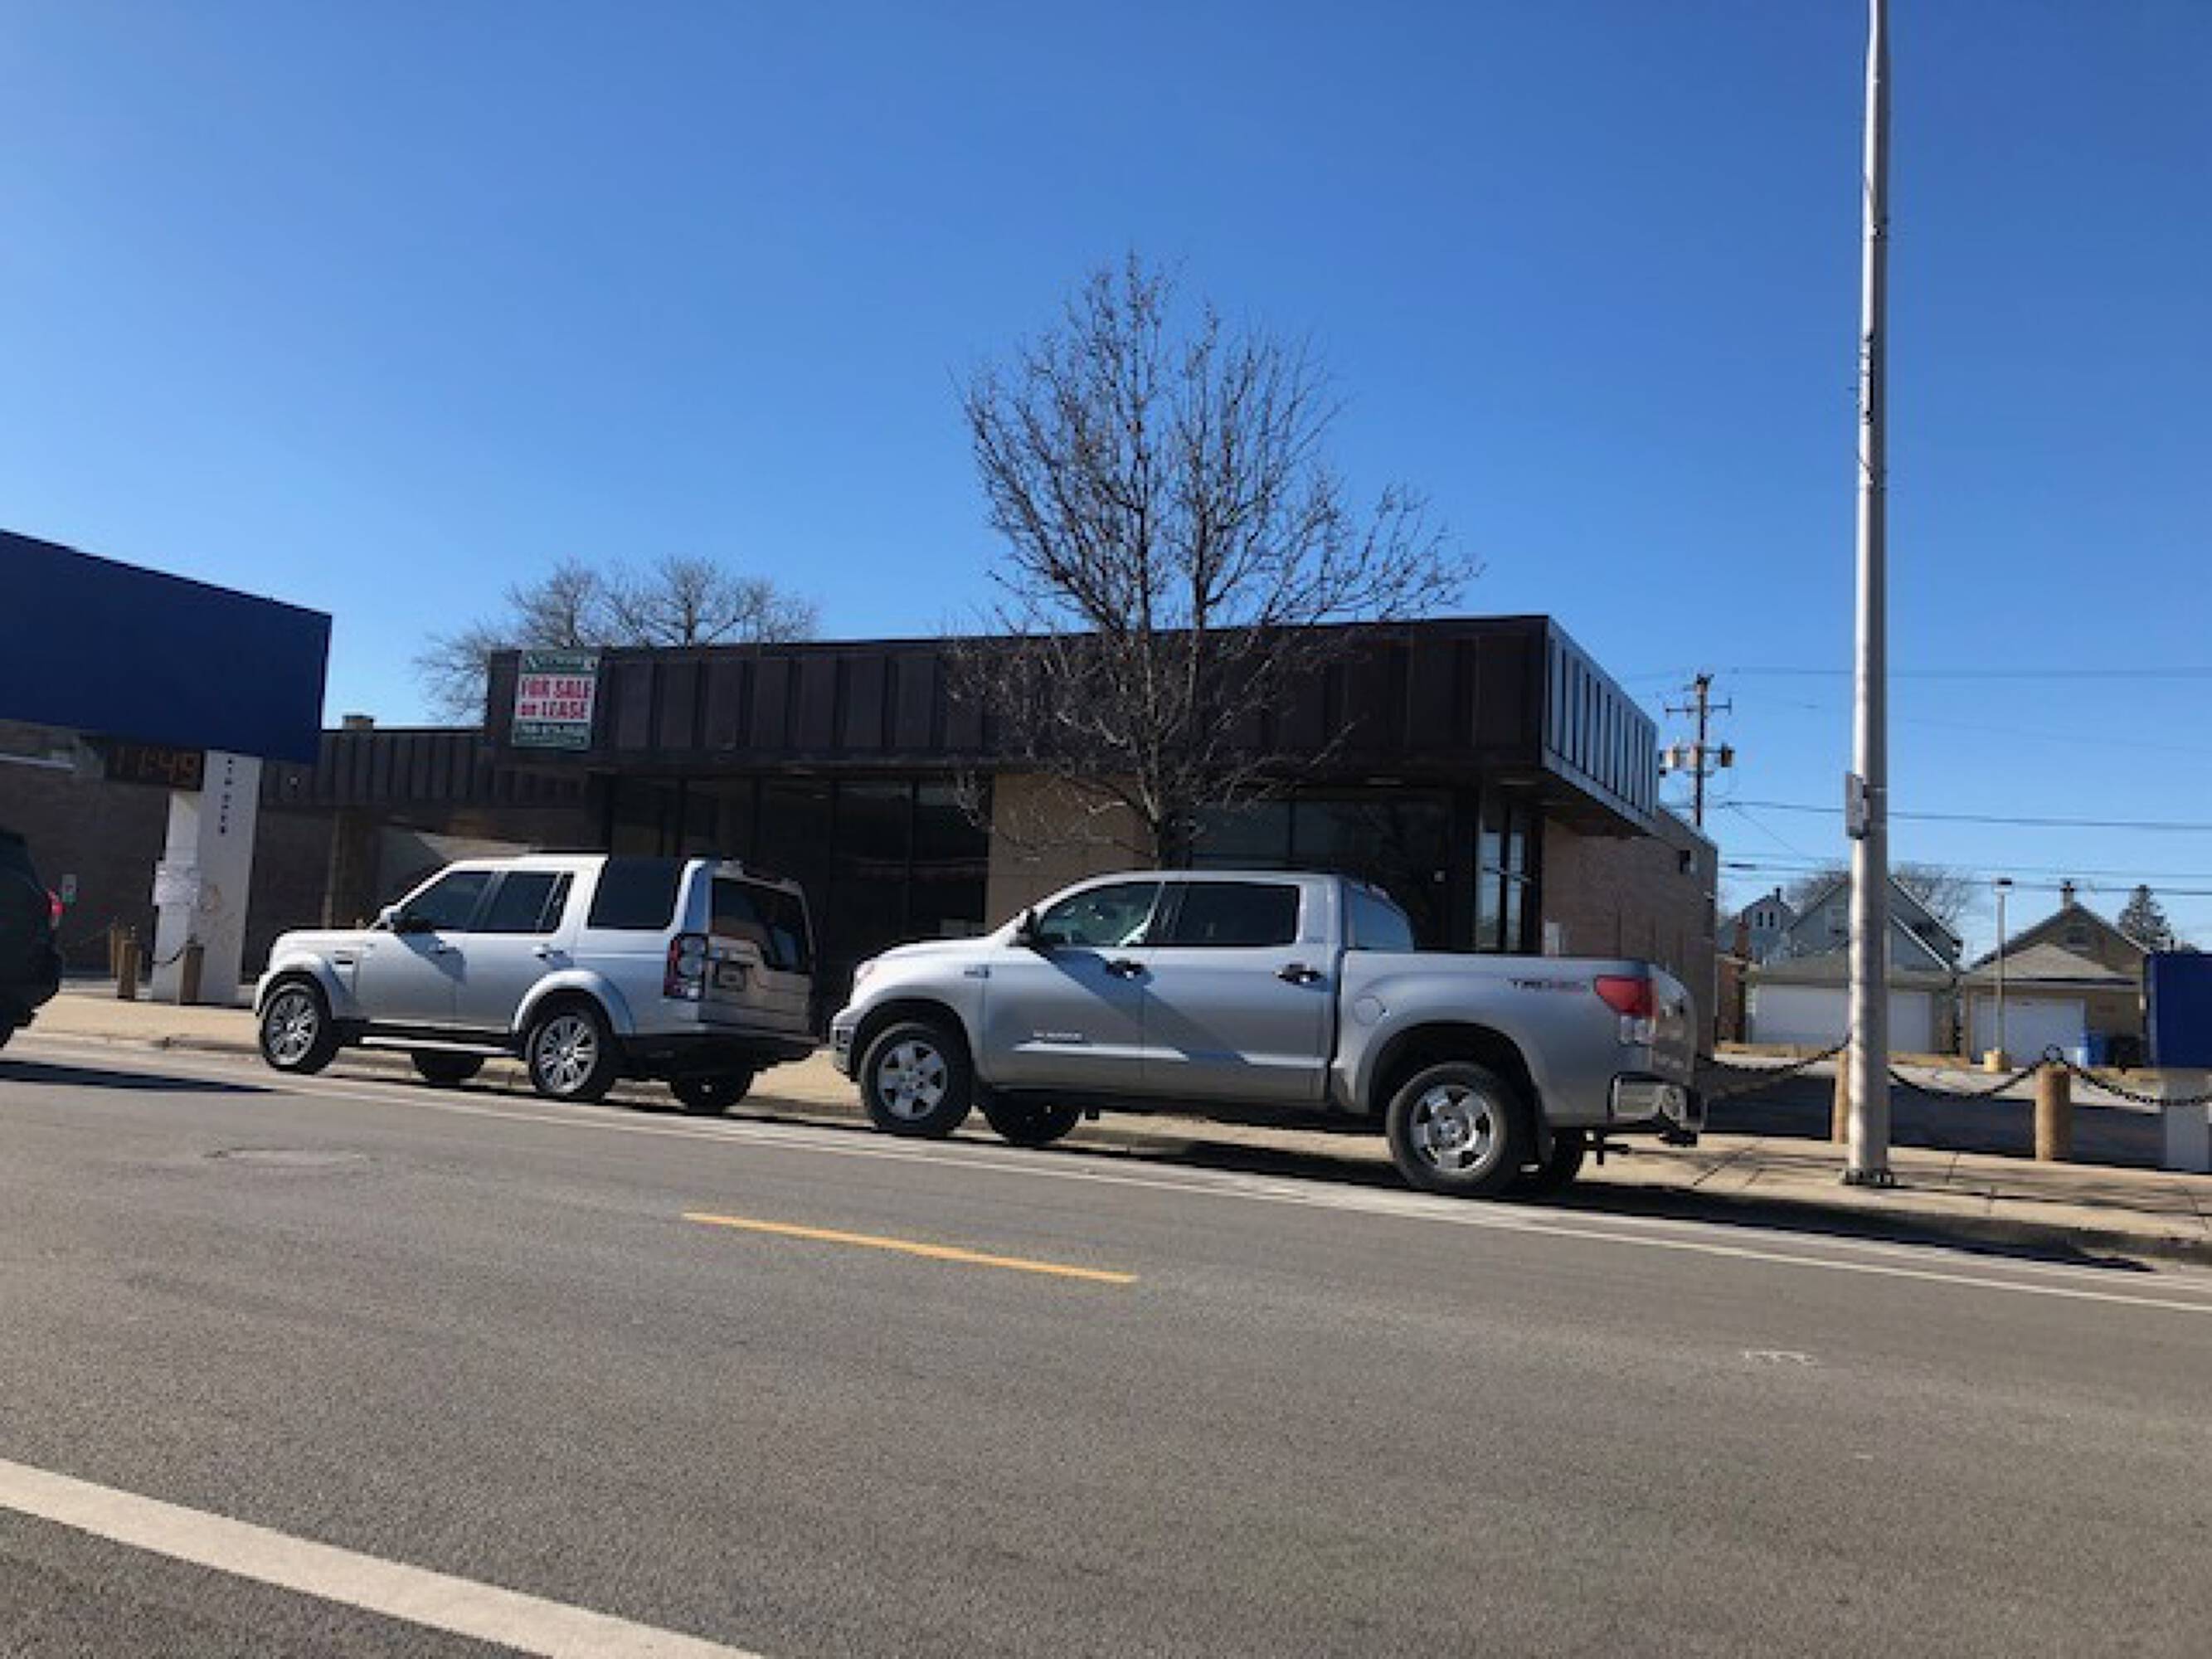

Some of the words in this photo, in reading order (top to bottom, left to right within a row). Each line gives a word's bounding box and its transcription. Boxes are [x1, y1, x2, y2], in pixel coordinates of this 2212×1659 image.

[521, 679, 551, 698] FOR
[554, 679, 592, 698] SALE
[542, 701, 586, 720] LEASE
